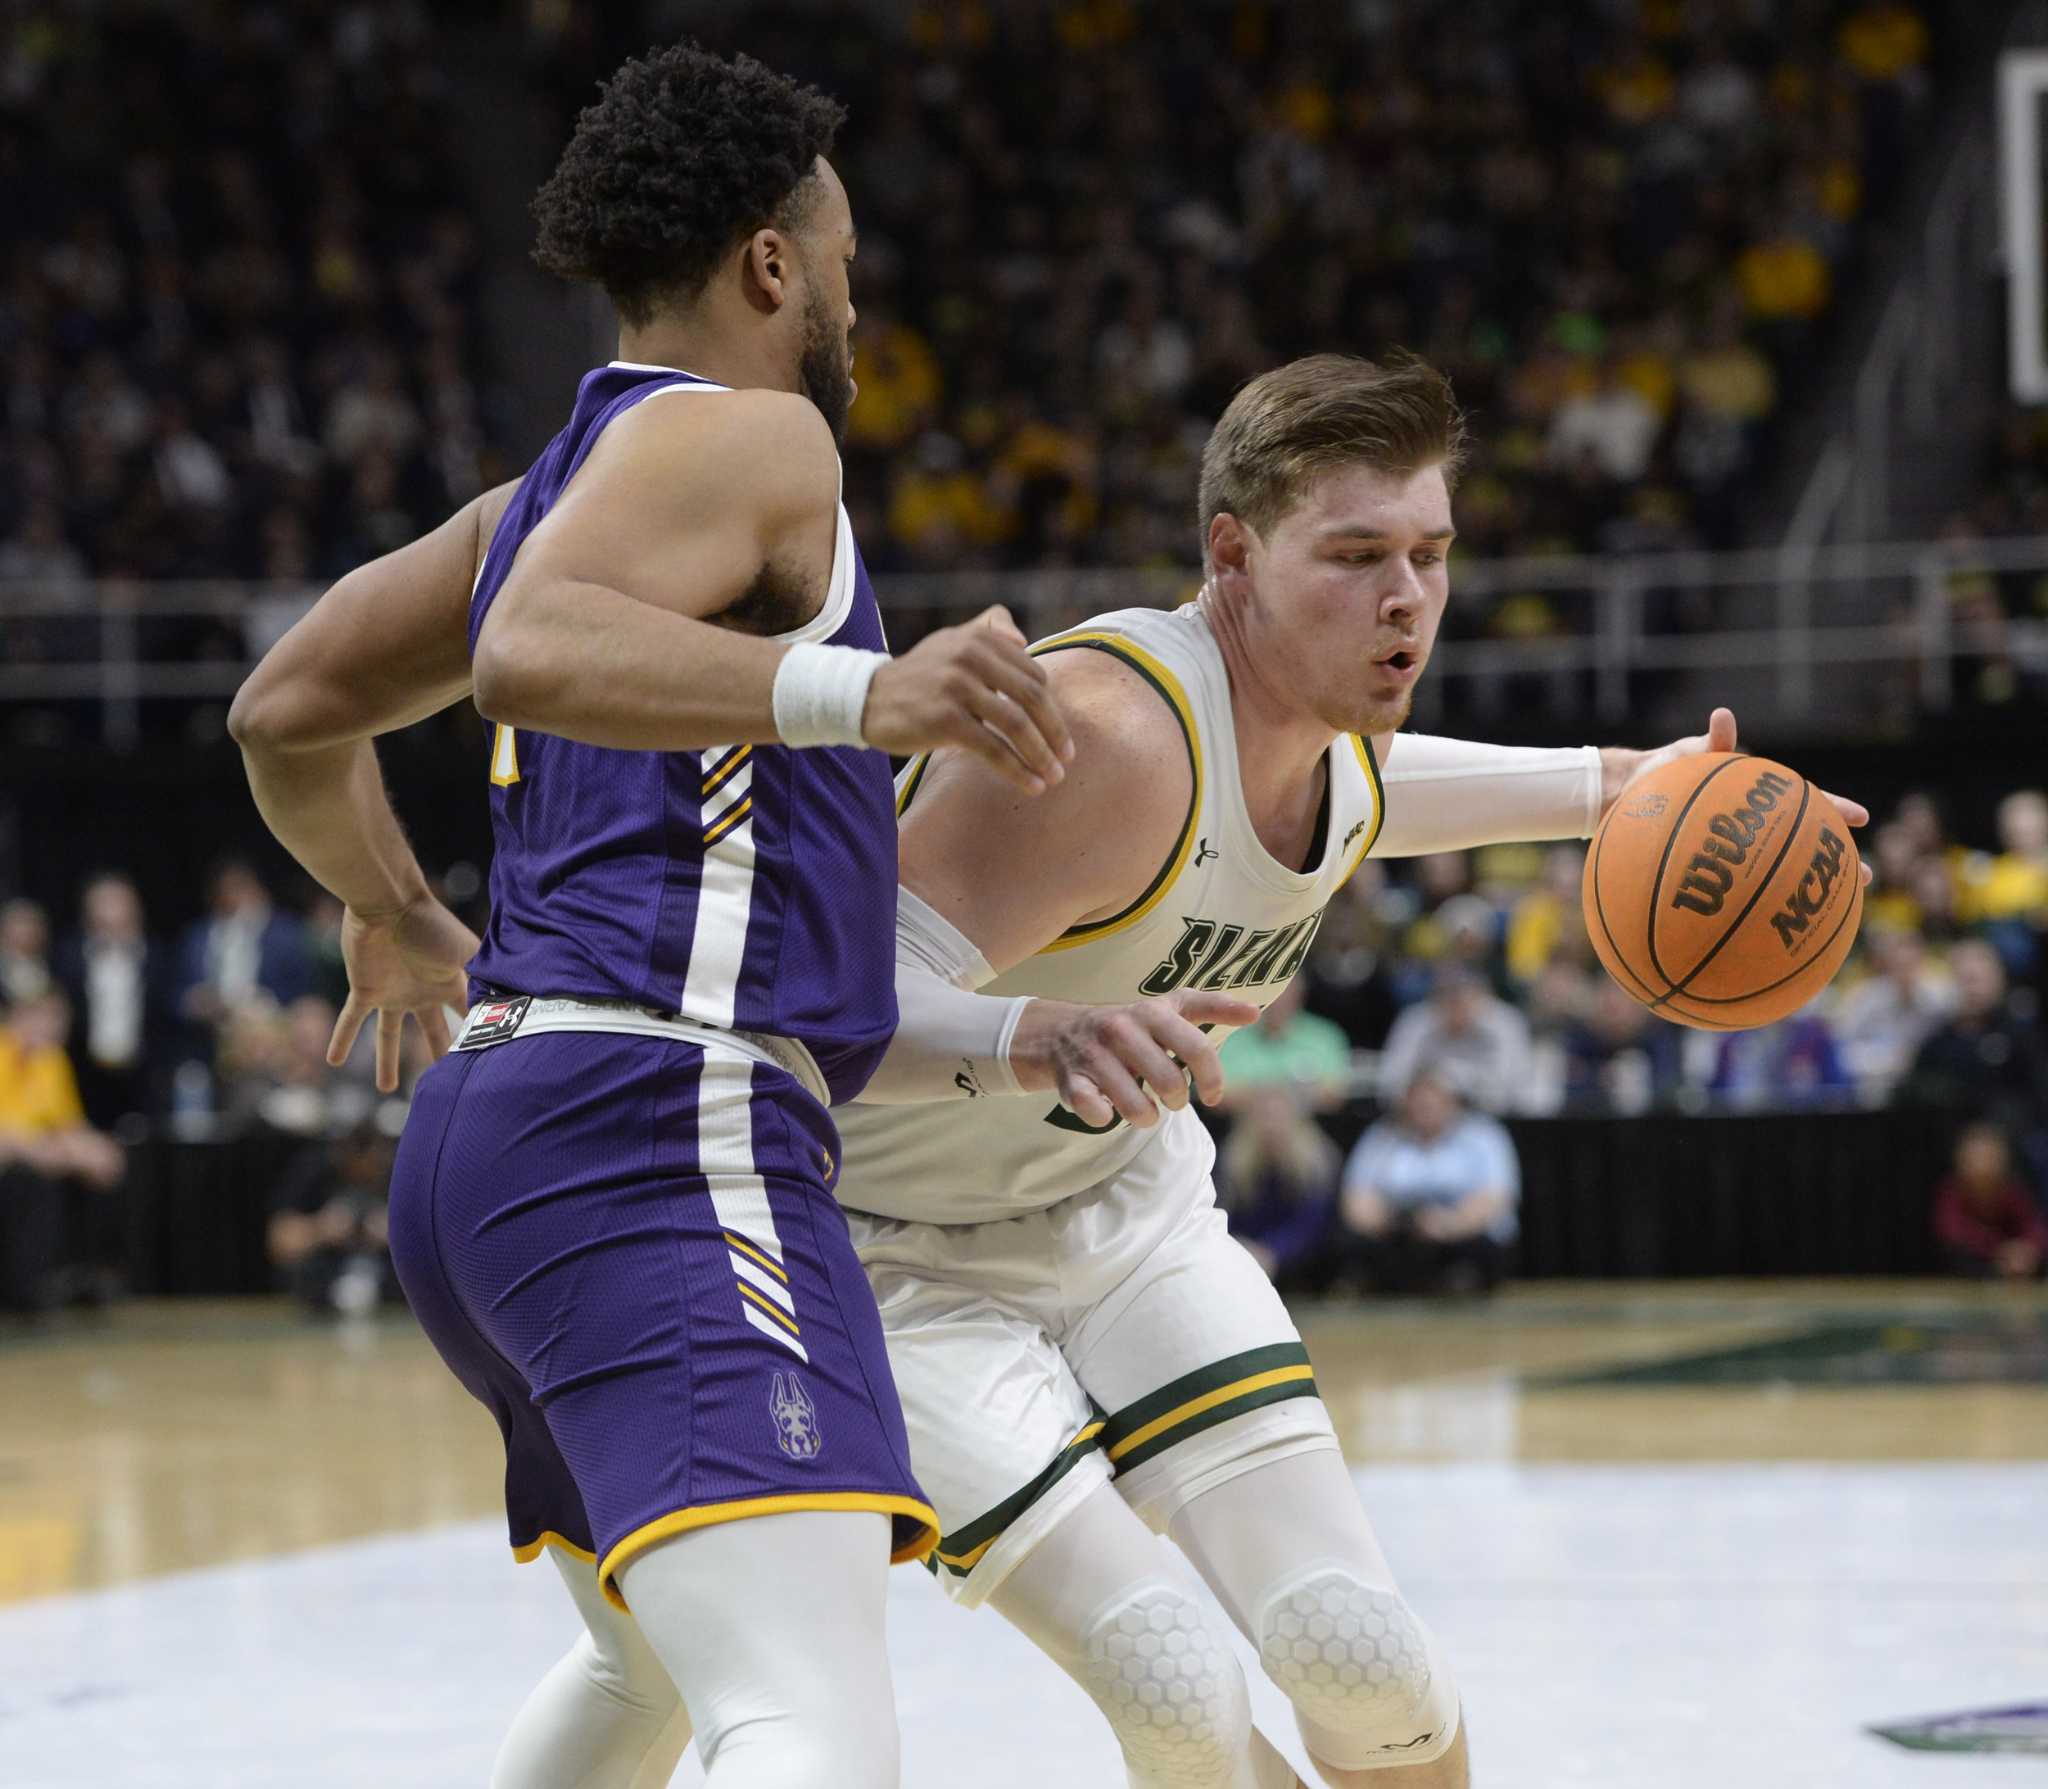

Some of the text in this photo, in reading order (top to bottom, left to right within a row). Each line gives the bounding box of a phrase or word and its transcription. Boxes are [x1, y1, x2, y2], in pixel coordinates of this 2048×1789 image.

[1671, 771, 1792, 917] Wilson
[1769, 826, 1845, 949] NCAA
[1138, 910, 1327, 997] SIENA
